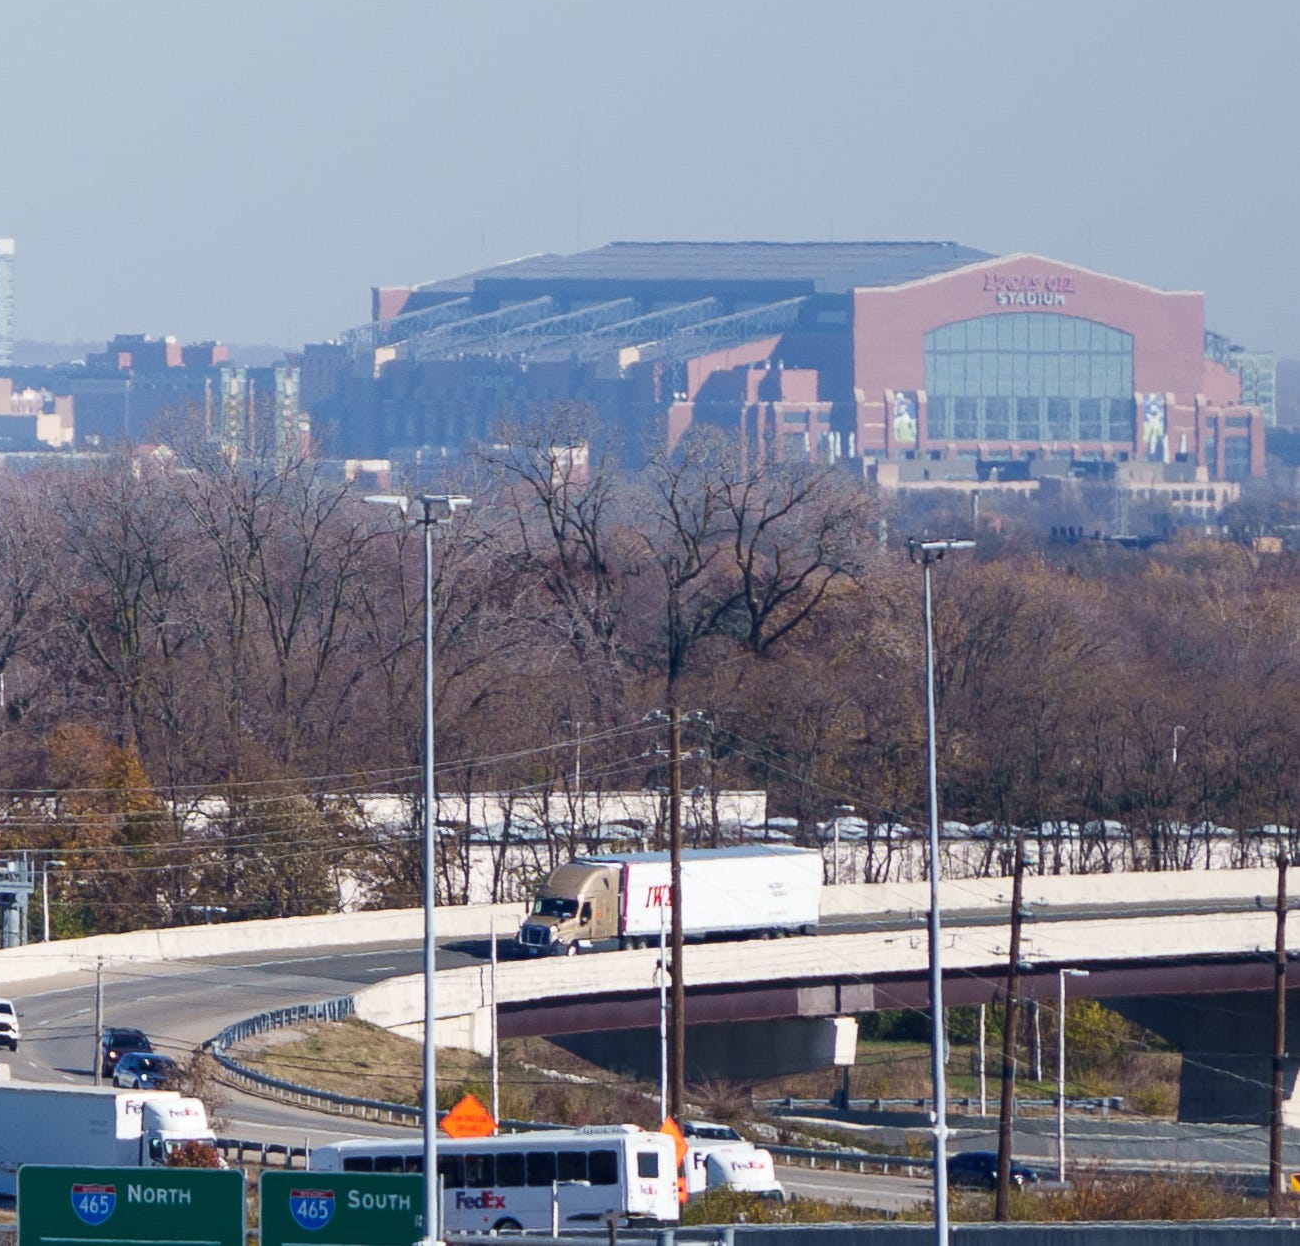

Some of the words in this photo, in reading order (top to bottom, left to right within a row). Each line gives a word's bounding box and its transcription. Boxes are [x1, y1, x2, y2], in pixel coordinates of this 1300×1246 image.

[983, 273, 1042, 292] LUCAS
[1044, 276, 1077, 294] OIL
[996, 292, 1065, 306] STADIUM
[168, 1106, 199, 1118] FedEx
[731, 1160, 765, 1171] FedEx
[79, 1195, 110, 1215] 465
[127, 1184, 191, 1204] NORTH
[297, 1199, 329, 1220] 465
[347, 1189, 411, 1211] SOUTH
[456, 1190, 506, 1210] FedEx
